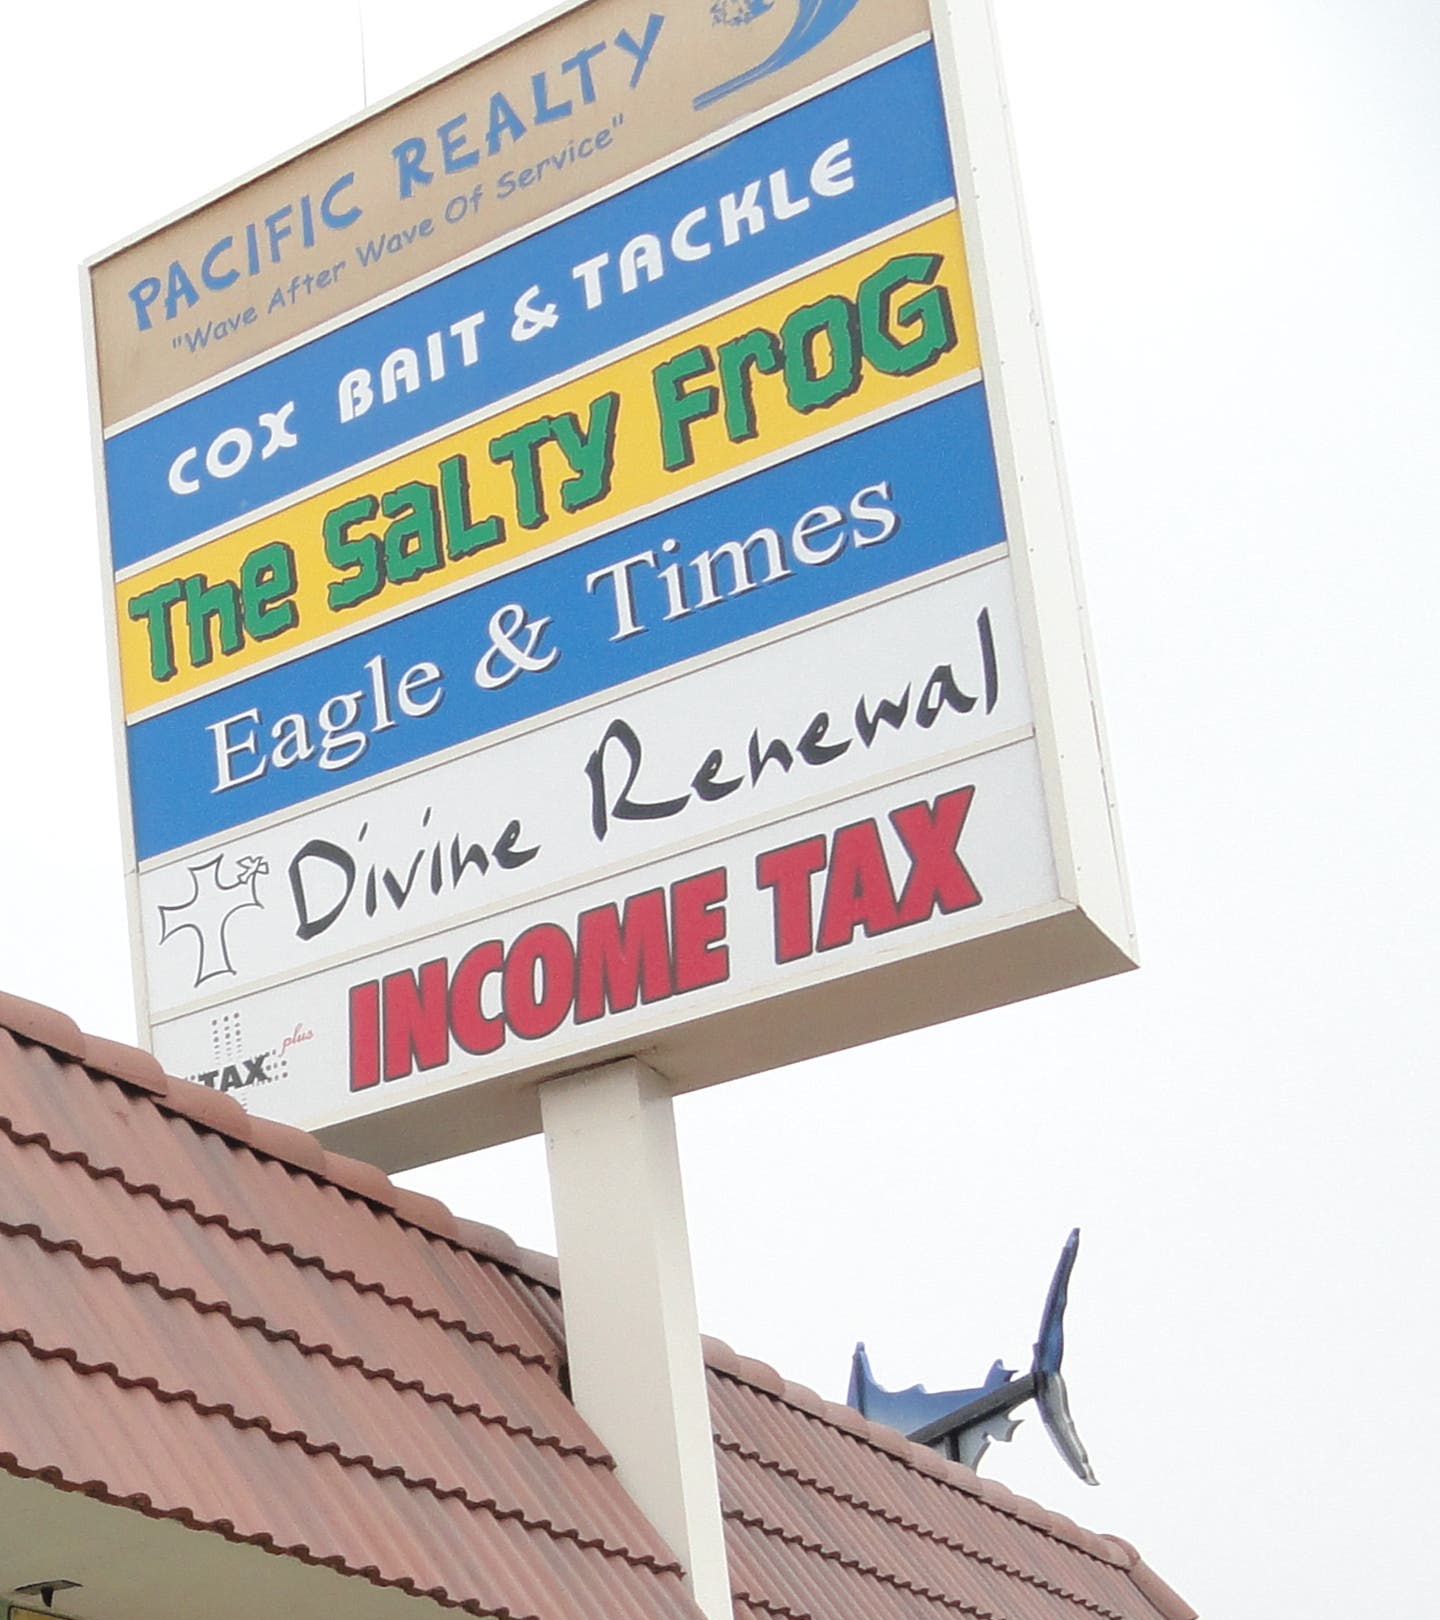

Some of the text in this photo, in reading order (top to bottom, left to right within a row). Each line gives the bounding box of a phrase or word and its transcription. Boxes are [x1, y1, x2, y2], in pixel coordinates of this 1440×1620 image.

[128, 13, 665, 331] PACIFIC REALTY
[167, 139, 855, 496] COX BAIT & TACKLE
[172, 113, 624, 353] "Wave After Wave Of Service"
[128, 540, 298, 682] The
[204, 479, 901, 794] Eagle & Times
[289, 606, 1001, 943] Divine Renewal
[198, 1023, 314, 1092] TAX plus
[347, 784, 983, 1093] INCOME TAX
